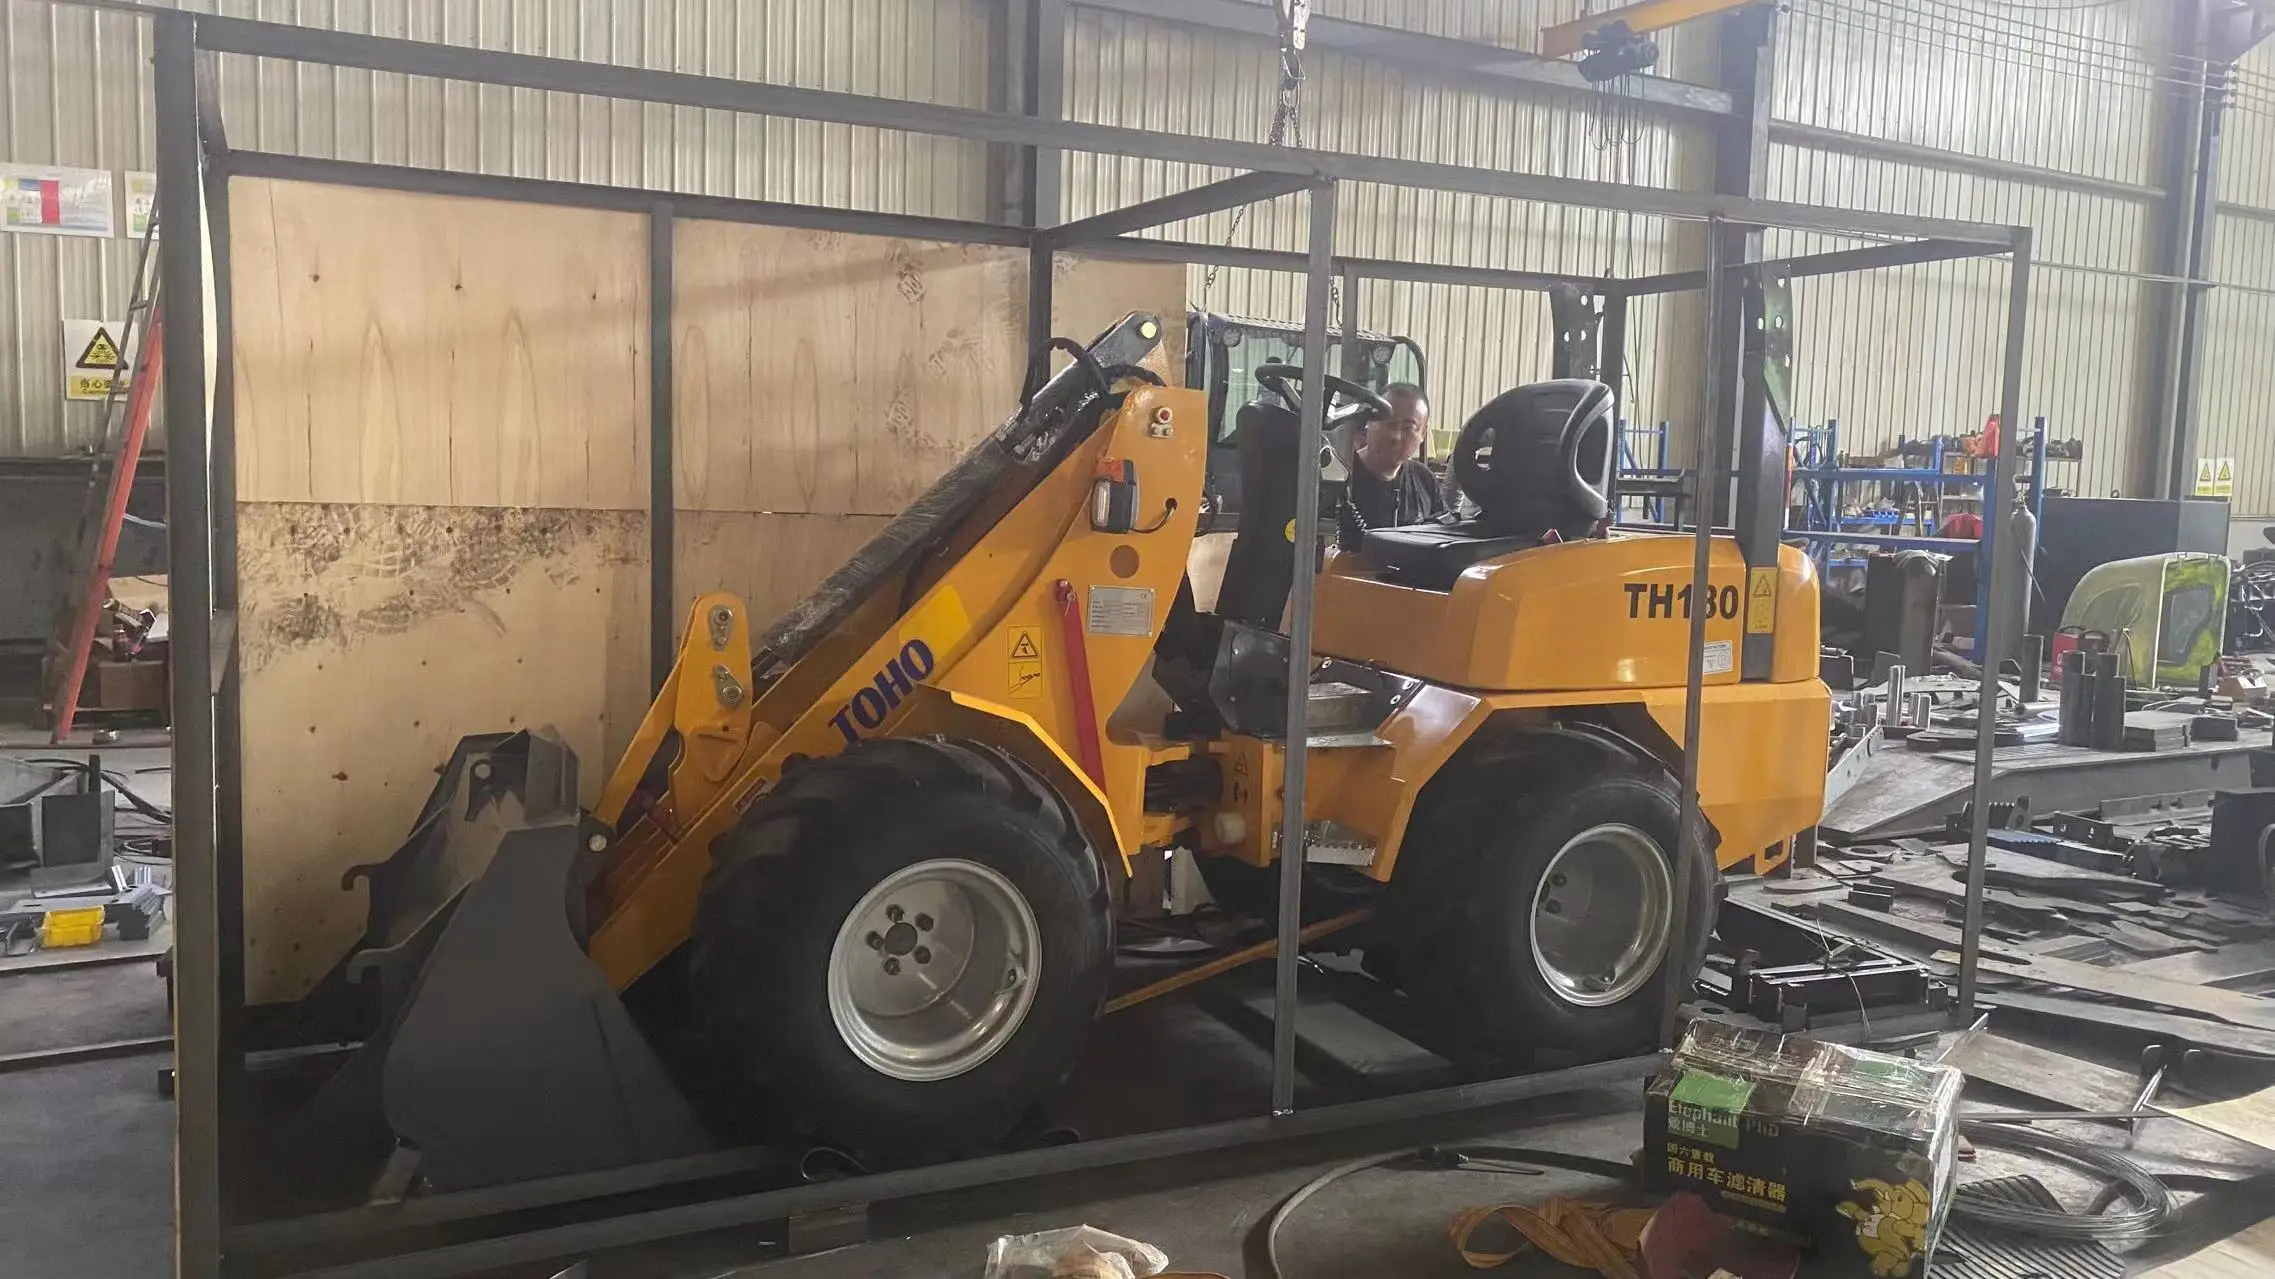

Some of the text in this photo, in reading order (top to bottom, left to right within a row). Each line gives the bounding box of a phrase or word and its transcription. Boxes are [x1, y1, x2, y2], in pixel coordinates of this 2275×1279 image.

[1624, 584, 1739, 619] TH180
[827, 639, 934, 743] TOHO
[1667, 1156, 1787, 1202] 商用车滤清器
